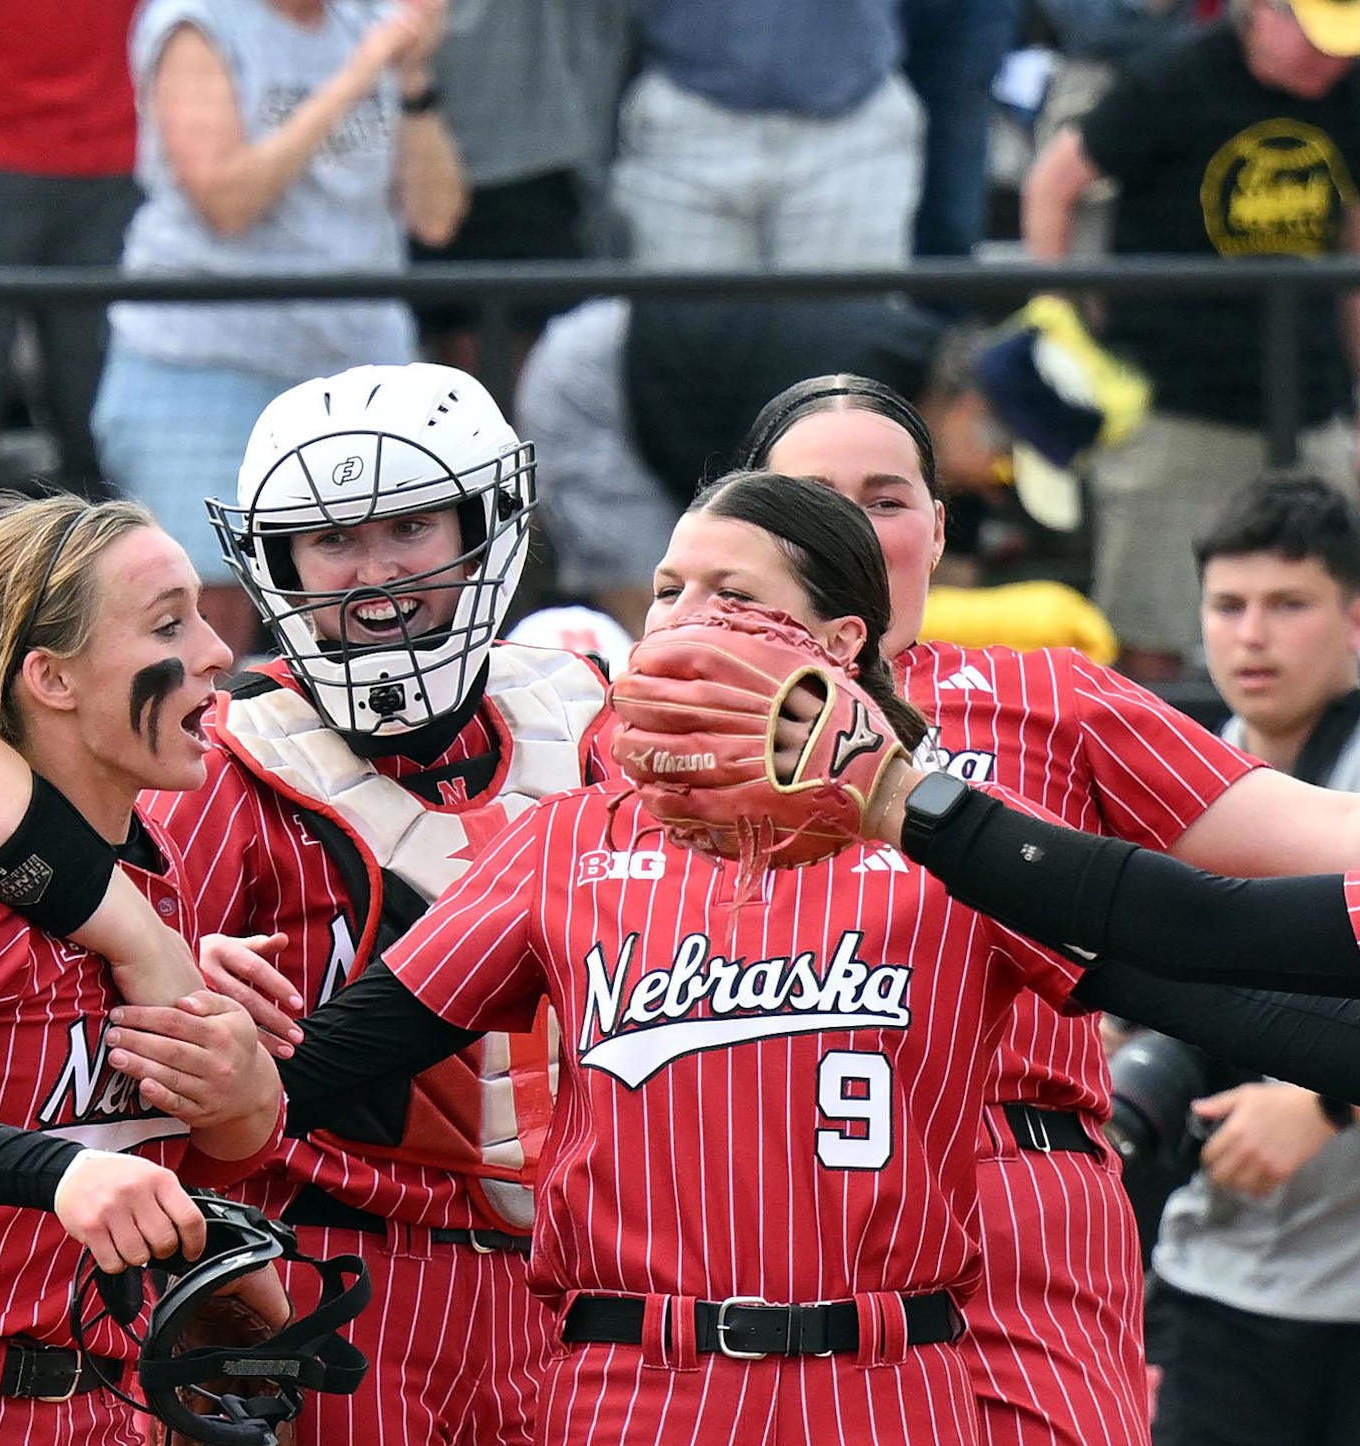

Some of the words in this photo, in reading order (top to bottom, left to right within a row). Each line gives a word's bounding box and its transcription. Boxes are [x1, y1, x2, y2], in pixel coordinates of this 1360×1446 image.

[653, 751, 716, 774] Mizuno
[437, 776, 469, 806] N
[577, 849, 667, 888] BIG
[577, 929, 913, 1056] Nebraska
[815, 1050, 894, 1171] 9
